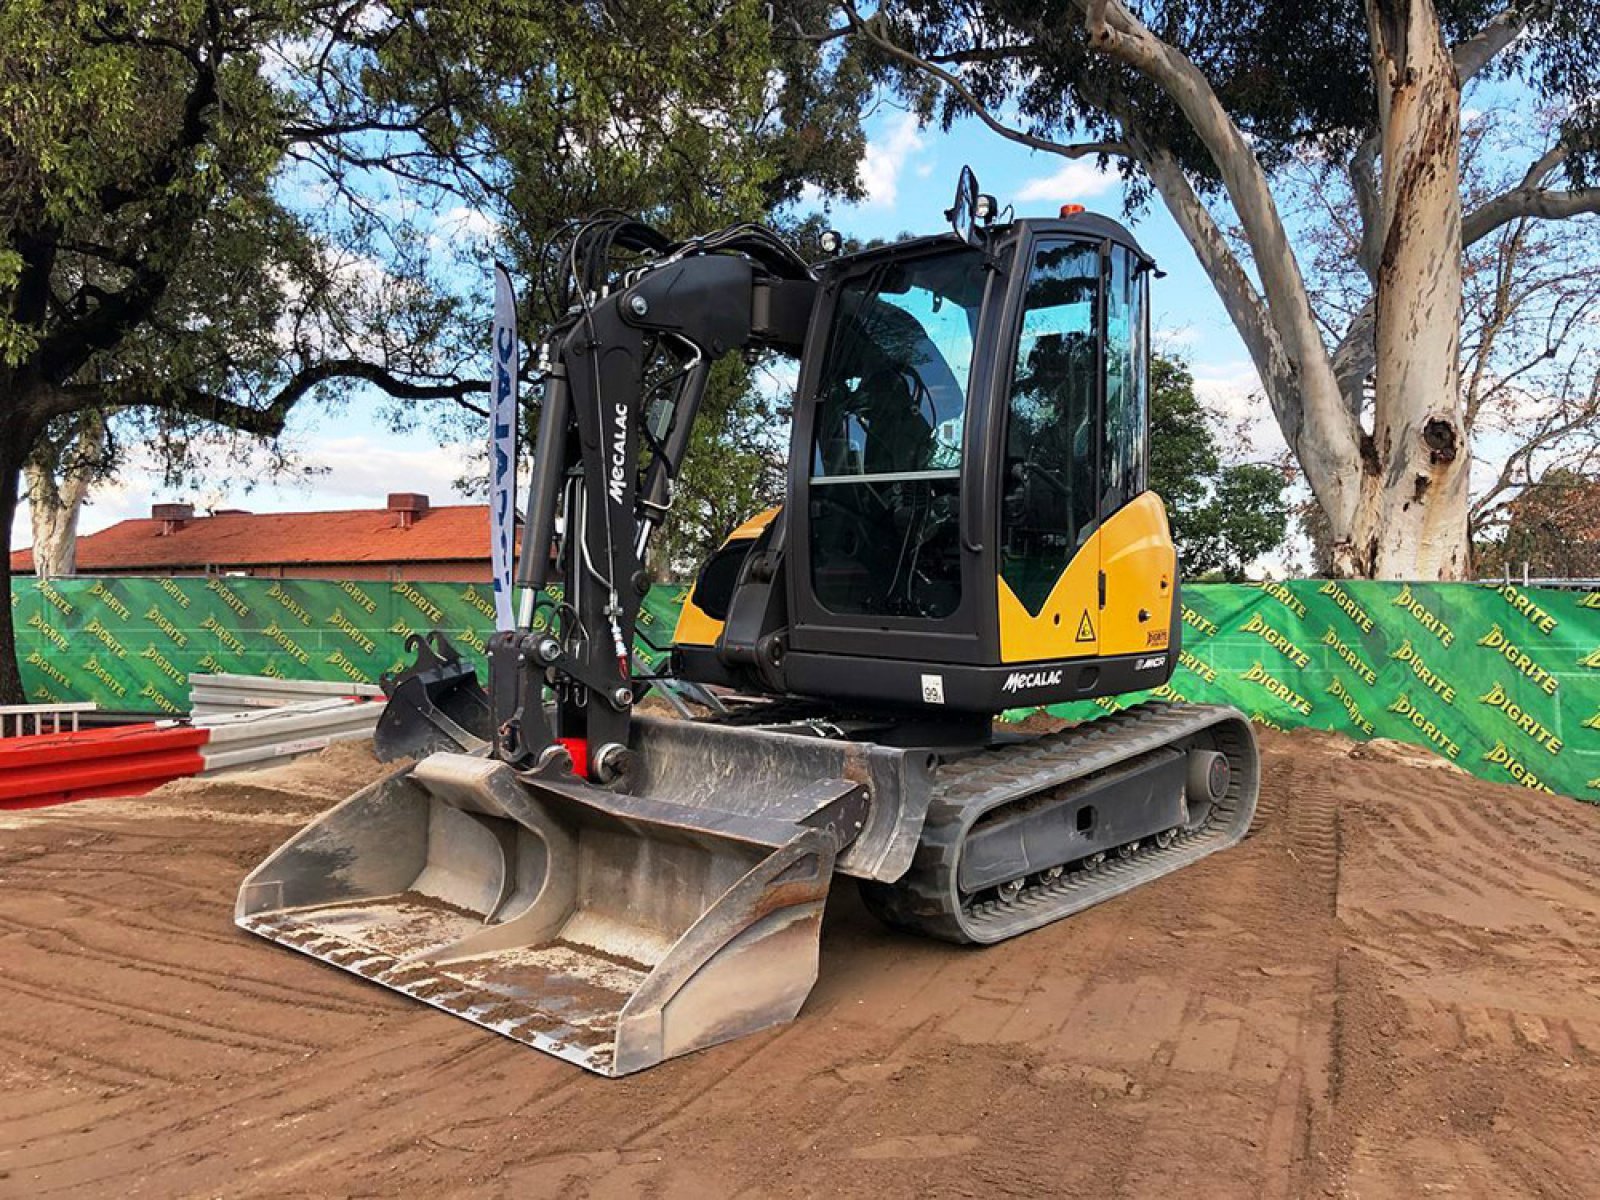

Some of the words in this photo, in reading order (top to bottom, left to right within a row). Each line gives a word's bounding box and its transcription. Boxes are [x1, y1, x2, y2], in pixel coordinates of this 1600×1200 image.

[34, 580, 73, 616] DIGRITE
[91, 582, 131, 622] DIGRITE
[156, 578, 190, 609] IGRITE
[207, 578, 248, 617] DIGRITE
[269, 582, 312, 625] DIGRITE
[334, 580, 377, 614] IGRITE
[392, 579, 442, 622] DIGRITE
[462, 586, 496, 620] DIGRI
[1260, 583, 1306, 618] IGRITE
[1320, 581, 1374, 633] DIGRITE
[28, 613, 70, 651] DIGRITE
[145, 605, 188, 648] DIGRITE
[200, 613, 245, 656] DIGRITE
[327, 609, 375, 654] DIGRITE
[1392, 584, 1455, 648] DIGRITE
[85, 618, 128, 658] DIGRITE
[262, 622, 309, 664] DIGRITE
[1241, 611, 1310, 668] DIGRITE
[1323, 624, 1377, 686] DIGRITE
[1476, 622, 1559, 695] DIGRITE
[27, 649, 71, 688] DIGRITE
[83, 654, 127, 697] DIGRITE
[141, 644, 186, 685] DIGRITE
[325, 650, 371, 683] DIGRIT
[1391, 640, 1456, 704] DIGRITE
[1242, 662, 1312, 716] DIGRITE
[1327, 675, 1376, 736] DIGRITE
[1388, 694, 1460, 759] DIGRITE
[1478, 681, 1563, 755] DIGRITE
